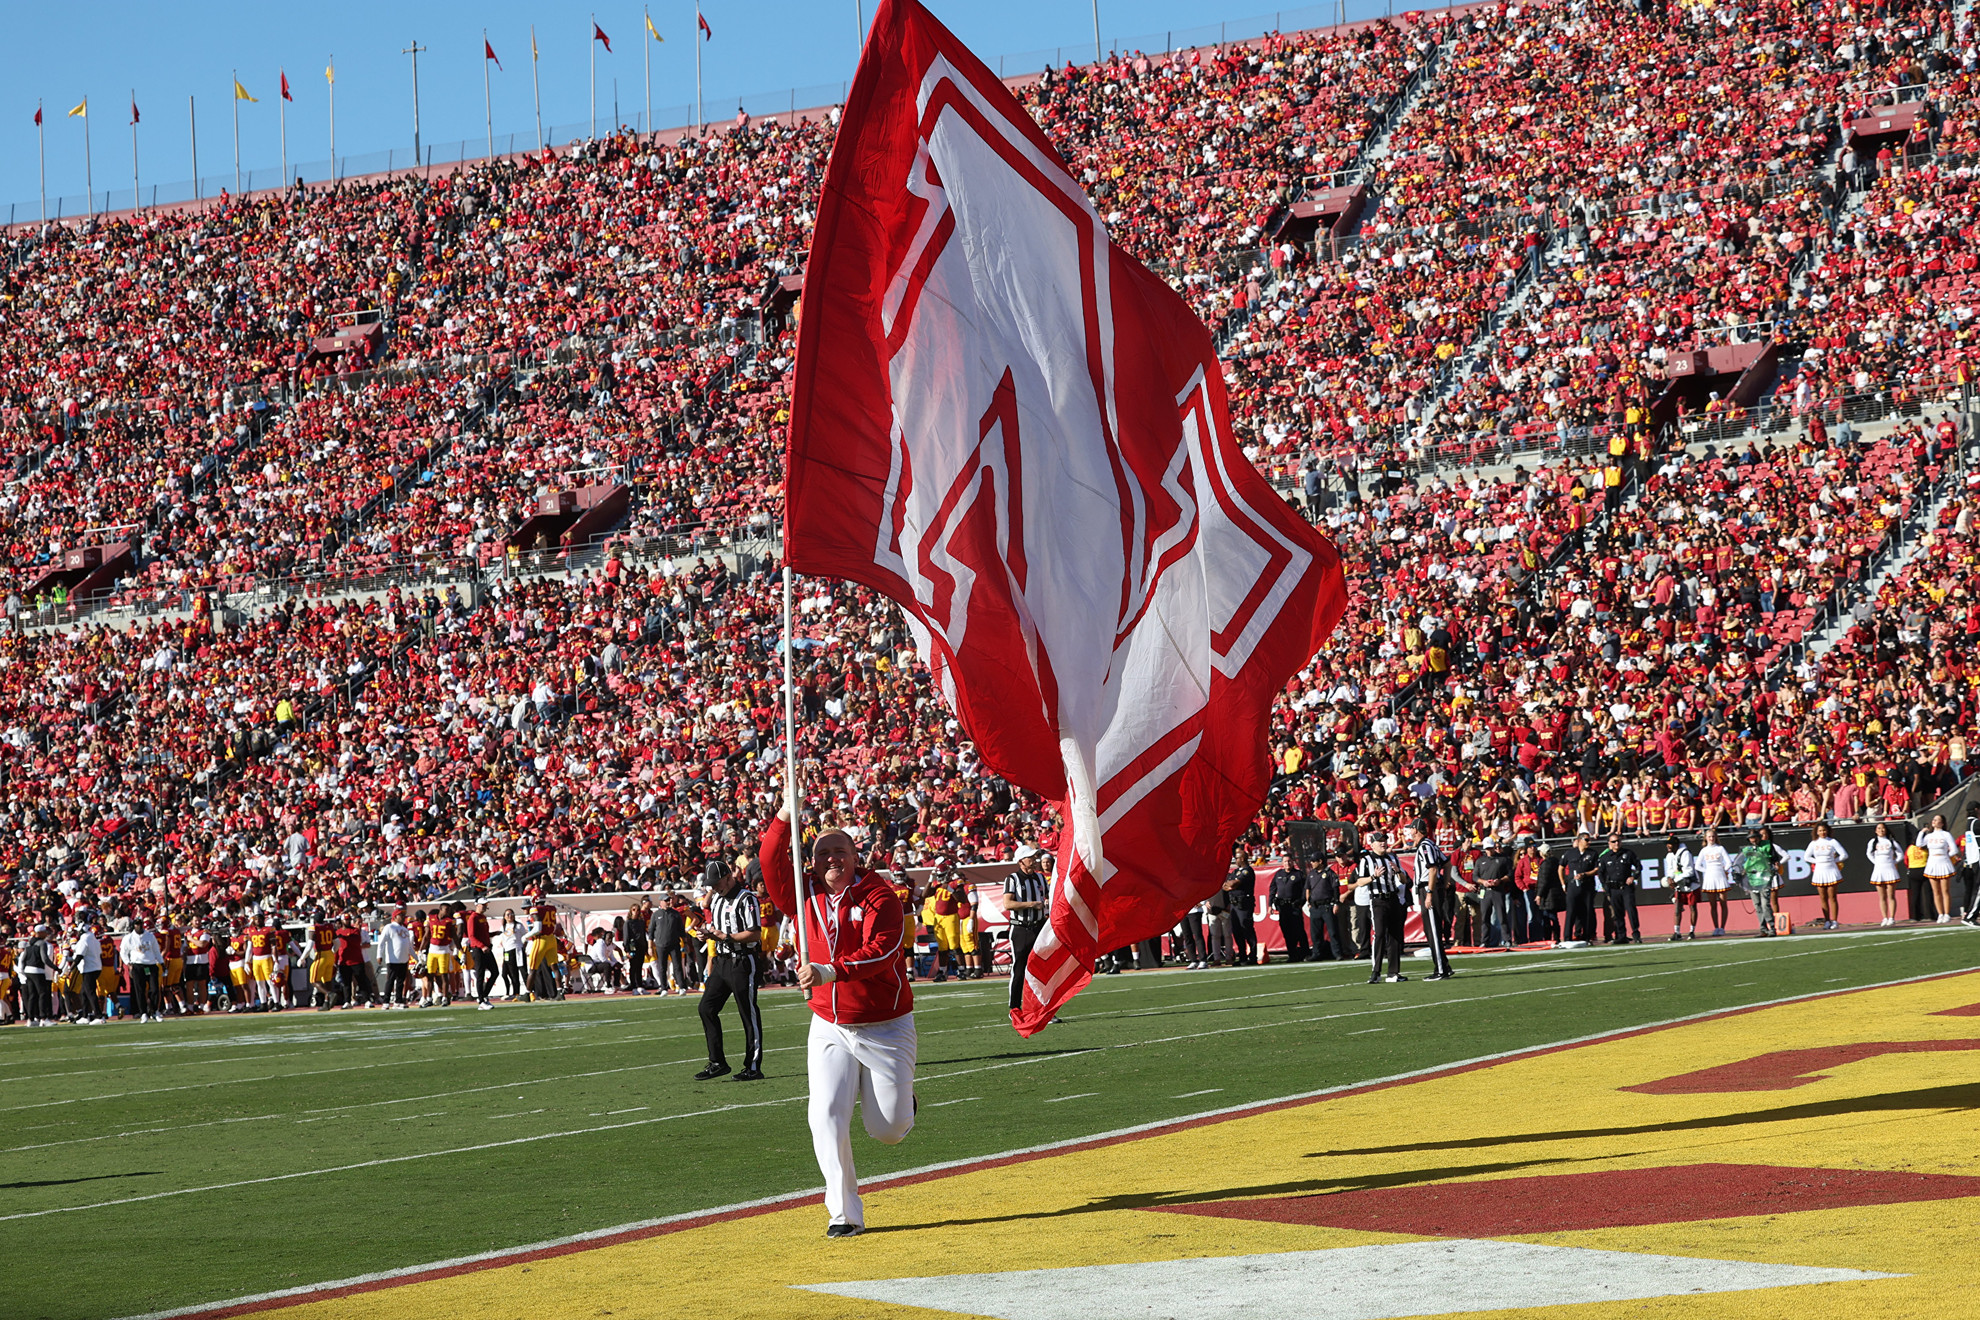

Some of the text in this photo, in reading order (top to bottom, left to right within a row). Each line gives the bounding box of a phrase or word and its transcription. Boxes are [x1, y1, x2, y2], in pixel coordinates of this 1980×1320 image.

[1675, 360, 1688, 370] 23
[546, 500, 554, 509] 21
[70, 555, 80, 565] 20
[432, 924, 446, 939] 15
[319, 930, 333, 945] 10
